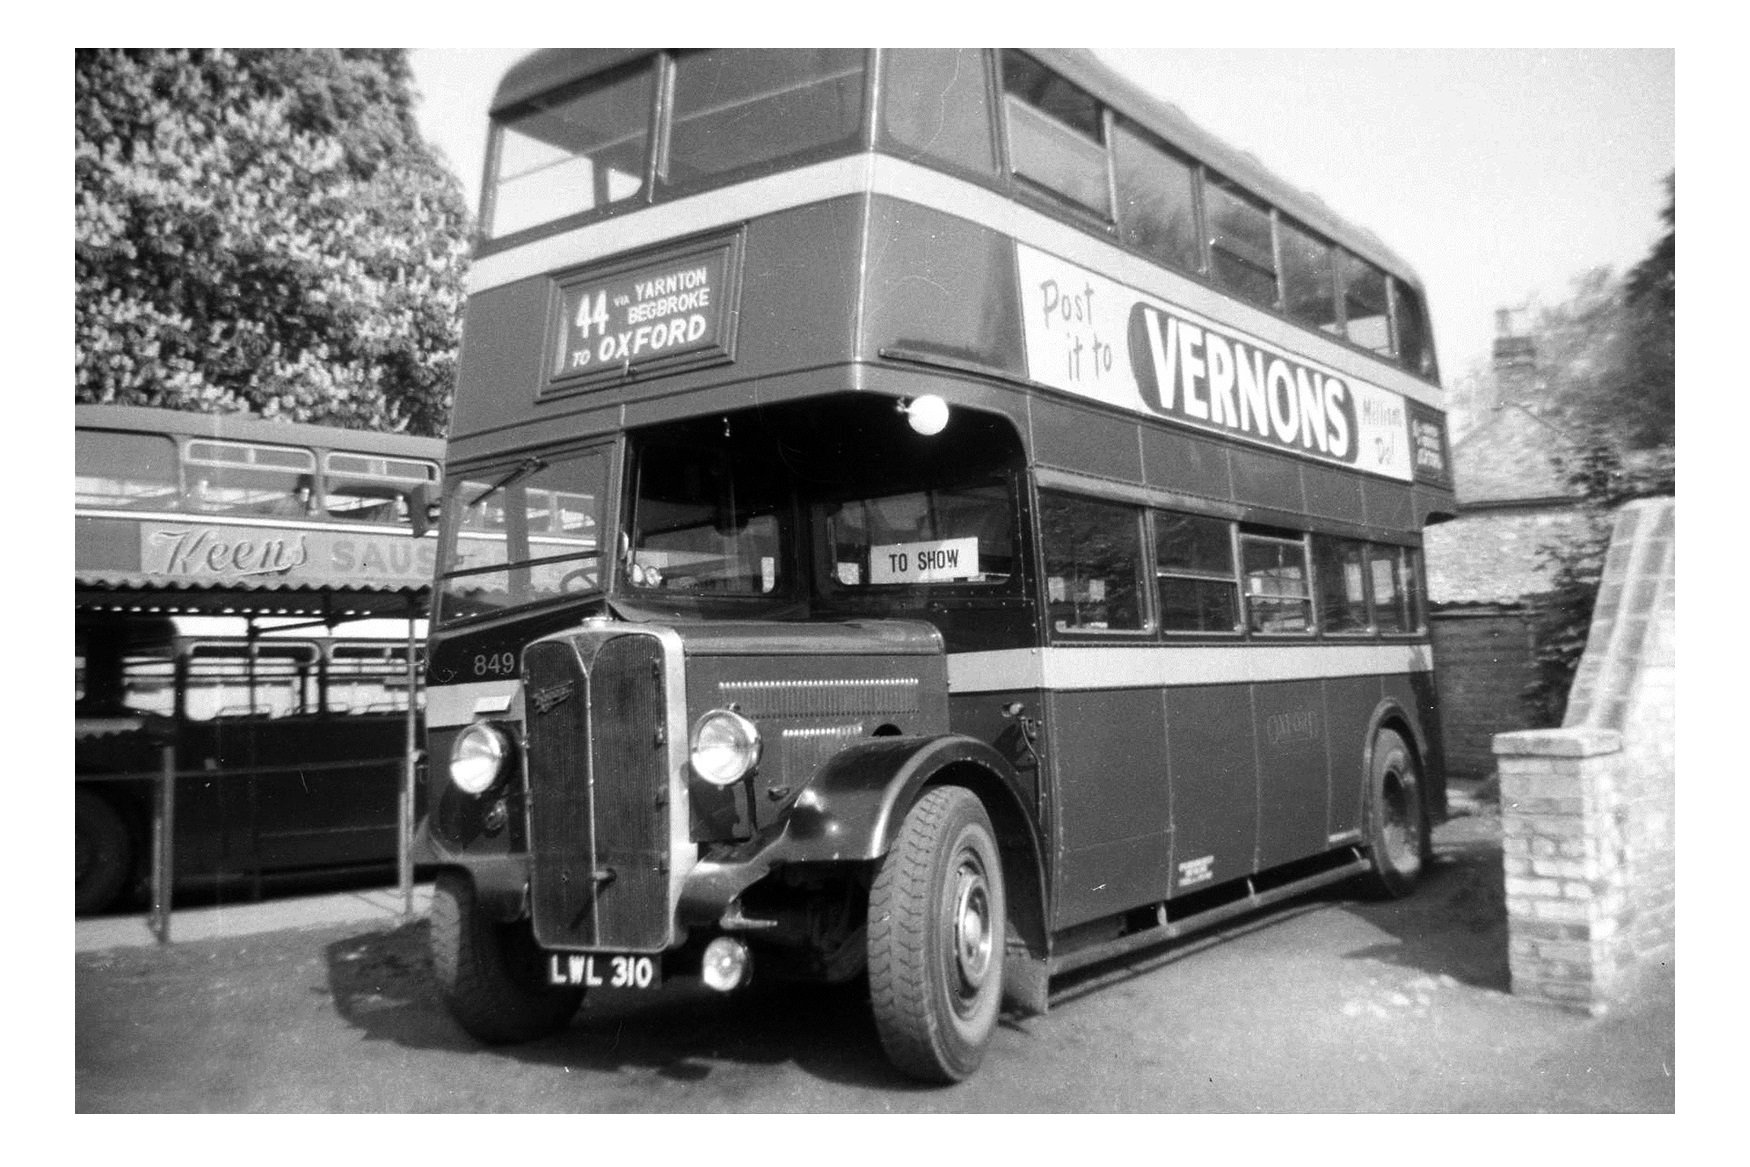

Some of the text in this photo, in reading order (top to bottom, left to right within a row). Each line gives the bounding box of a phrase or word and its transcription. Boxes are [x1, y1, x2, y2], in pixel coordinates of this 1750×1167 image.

[628, 288, 710, 325] BEGBROKE
[635, 267, 707, 301] YARNTON
[1040, 280, 1094, 329] Post
[576, 289, 609, 339] 44
[572, 314, 707, 368] TO OXFORD
[1067, 332, 1112, 382] it to
[1144, 307, 1350, 458] VERNONS
[153, 530, 309, 577] Keens
[889, 549, 960, 573] TO SHOW
[473, 652, 515, 676] 849
[551, 954, 653, 989] LWL 310
